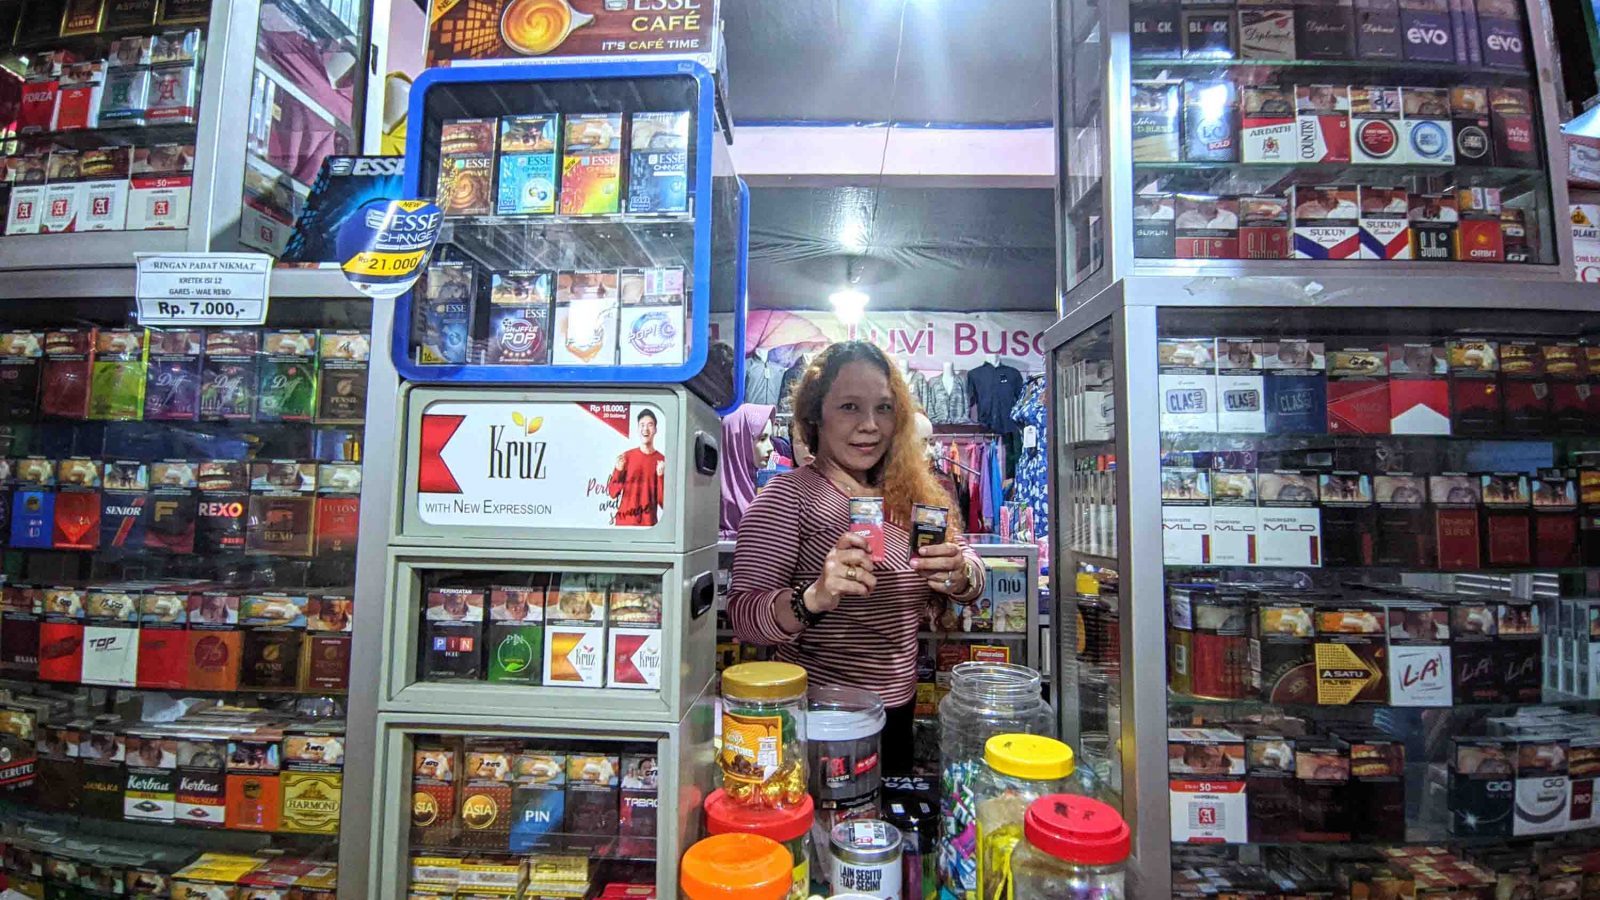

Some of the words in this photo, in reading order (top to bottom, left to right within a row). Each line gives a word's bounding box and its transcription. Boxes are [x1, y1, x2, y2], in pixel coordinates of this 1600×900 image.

[631, 10, 701, 31] CAFÉ
[1407, 27, 1448, 45] evo
[602, 41, 626, 51] IT'S
[629, 38, 664, 50] CAFÉ
[667, 39, 700, 48] TIME
[1486, 34, 1523, 53] evo
[1301, 119, 1315, 160] COUNTRY
[466, 158, 490, 168] ESSE
[591, 156, 616, 166] ESSE
[659, 153, 685, 164] ESSE
[390, 212, 440, 231] ESSE
[1366, 221, 1402, 229] SUKUN
[376, 230, 434, 246] CHANGE
[1310, 228, 1346, 237] SUKUN
[1470, 248, 1498, 258] ORBIT
[153, 261, 187, 270] RINGAN
[189, 261, 218, 270] PADAT
[220, 262, 256, 270] NIKMAT
[369, 256, 418, 271] 21.000
[158, 302, 185, 317] Rp.
[189, 302, 246, 318] 7.000,-
[445, 304, 467, 313] ESSE
[525, 309, 547, 318] ESSE
[506, 325, 539, 333] SHUFFLE
[501, 332, 537, 344] POP
[590, 404, 601, 414] Rp
[487, 424, 548, 480] Kruz
[599, 489, 622, 511] and
[105, 505, 142, 516] SENIOR
[199, 502, 244, 518] REXO
[425, 503, 451, 513] WITH
[1161, 523, 1207, 531] MLD
[1263, 523, 1316, 532] MLD
[264, 530, 294, 542] REXO
[89, 636, 117, 650] TOP
[575, 649, 596, 666] Kruz
[639, 651, 661, 669] Kruz
[127, 775, 170, 791] Kerbau
[180, 777, 219, 792] Kerbau
[826, 774, 850, 783] FILTER
[413, 802, 434, 816] SIA
[525, 810, 550, 823] PIN
[855, 868, 882, 881] SEGITU
[855, 879, 881, 892] SEGINI
